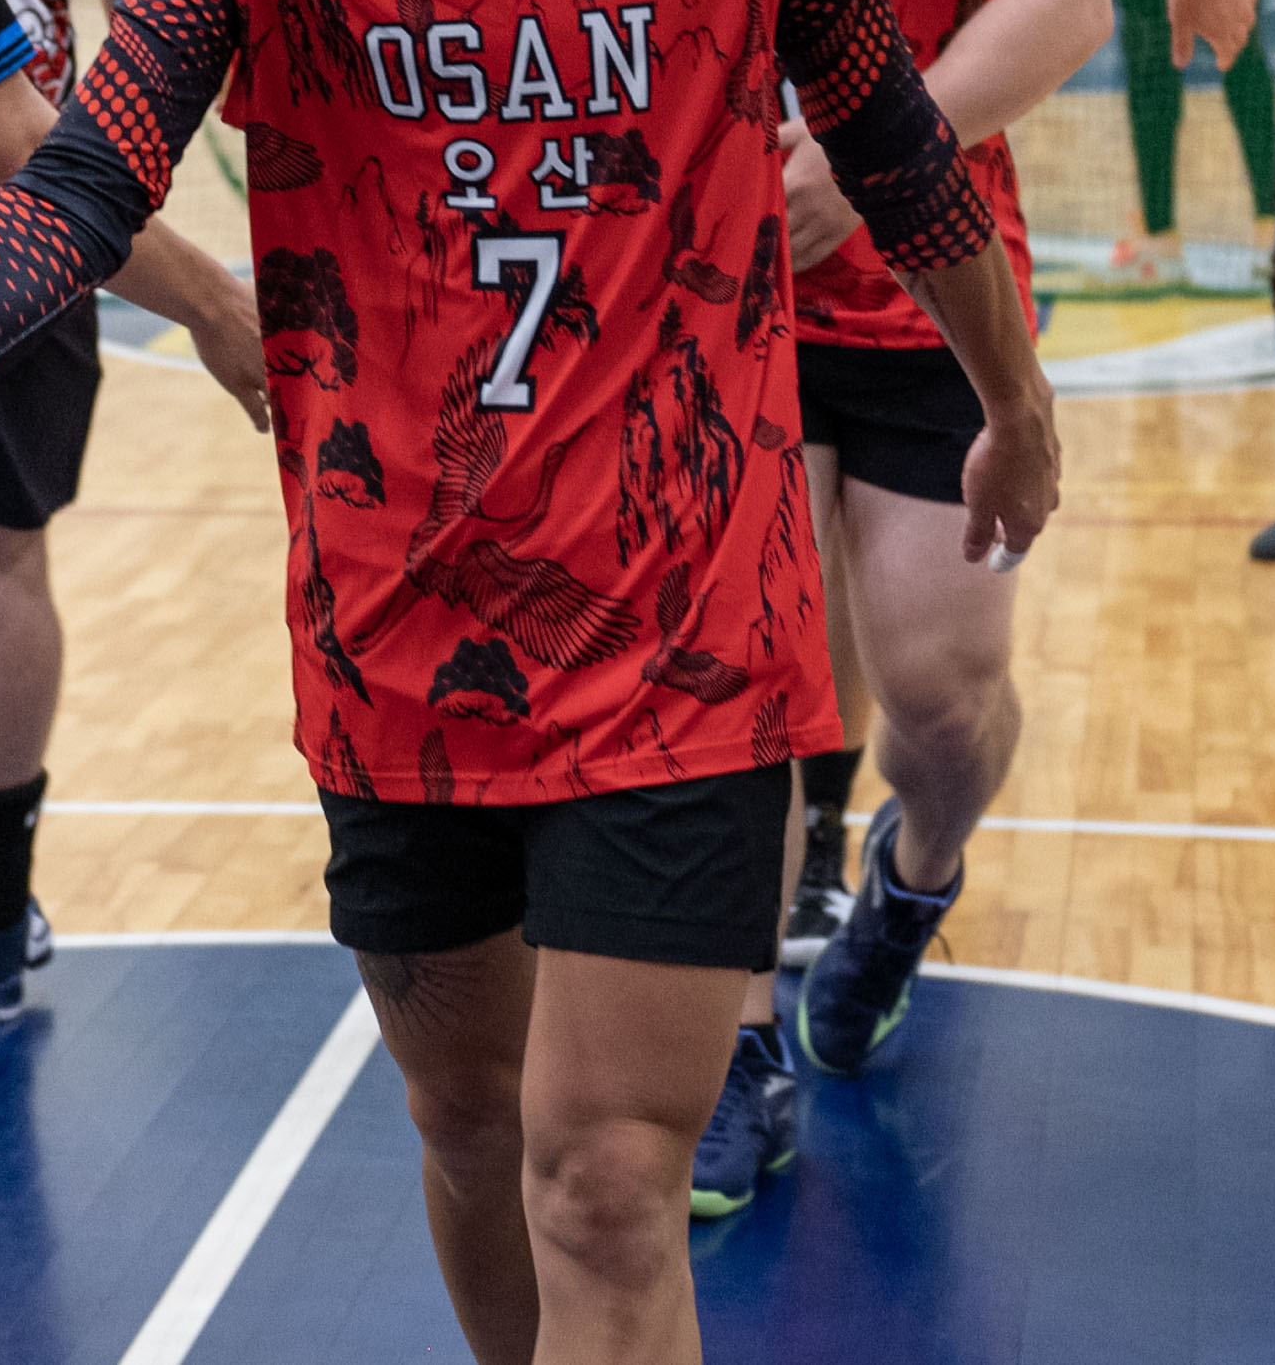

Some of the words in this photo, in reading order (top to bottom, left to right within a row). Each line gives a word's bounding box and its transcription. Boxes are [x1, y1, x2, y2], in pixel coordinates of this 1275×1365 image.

[364, 4, 655, 124] OSAN
[441, 136, 595, 211] 오산
[475, 233, 562, 409] 7
